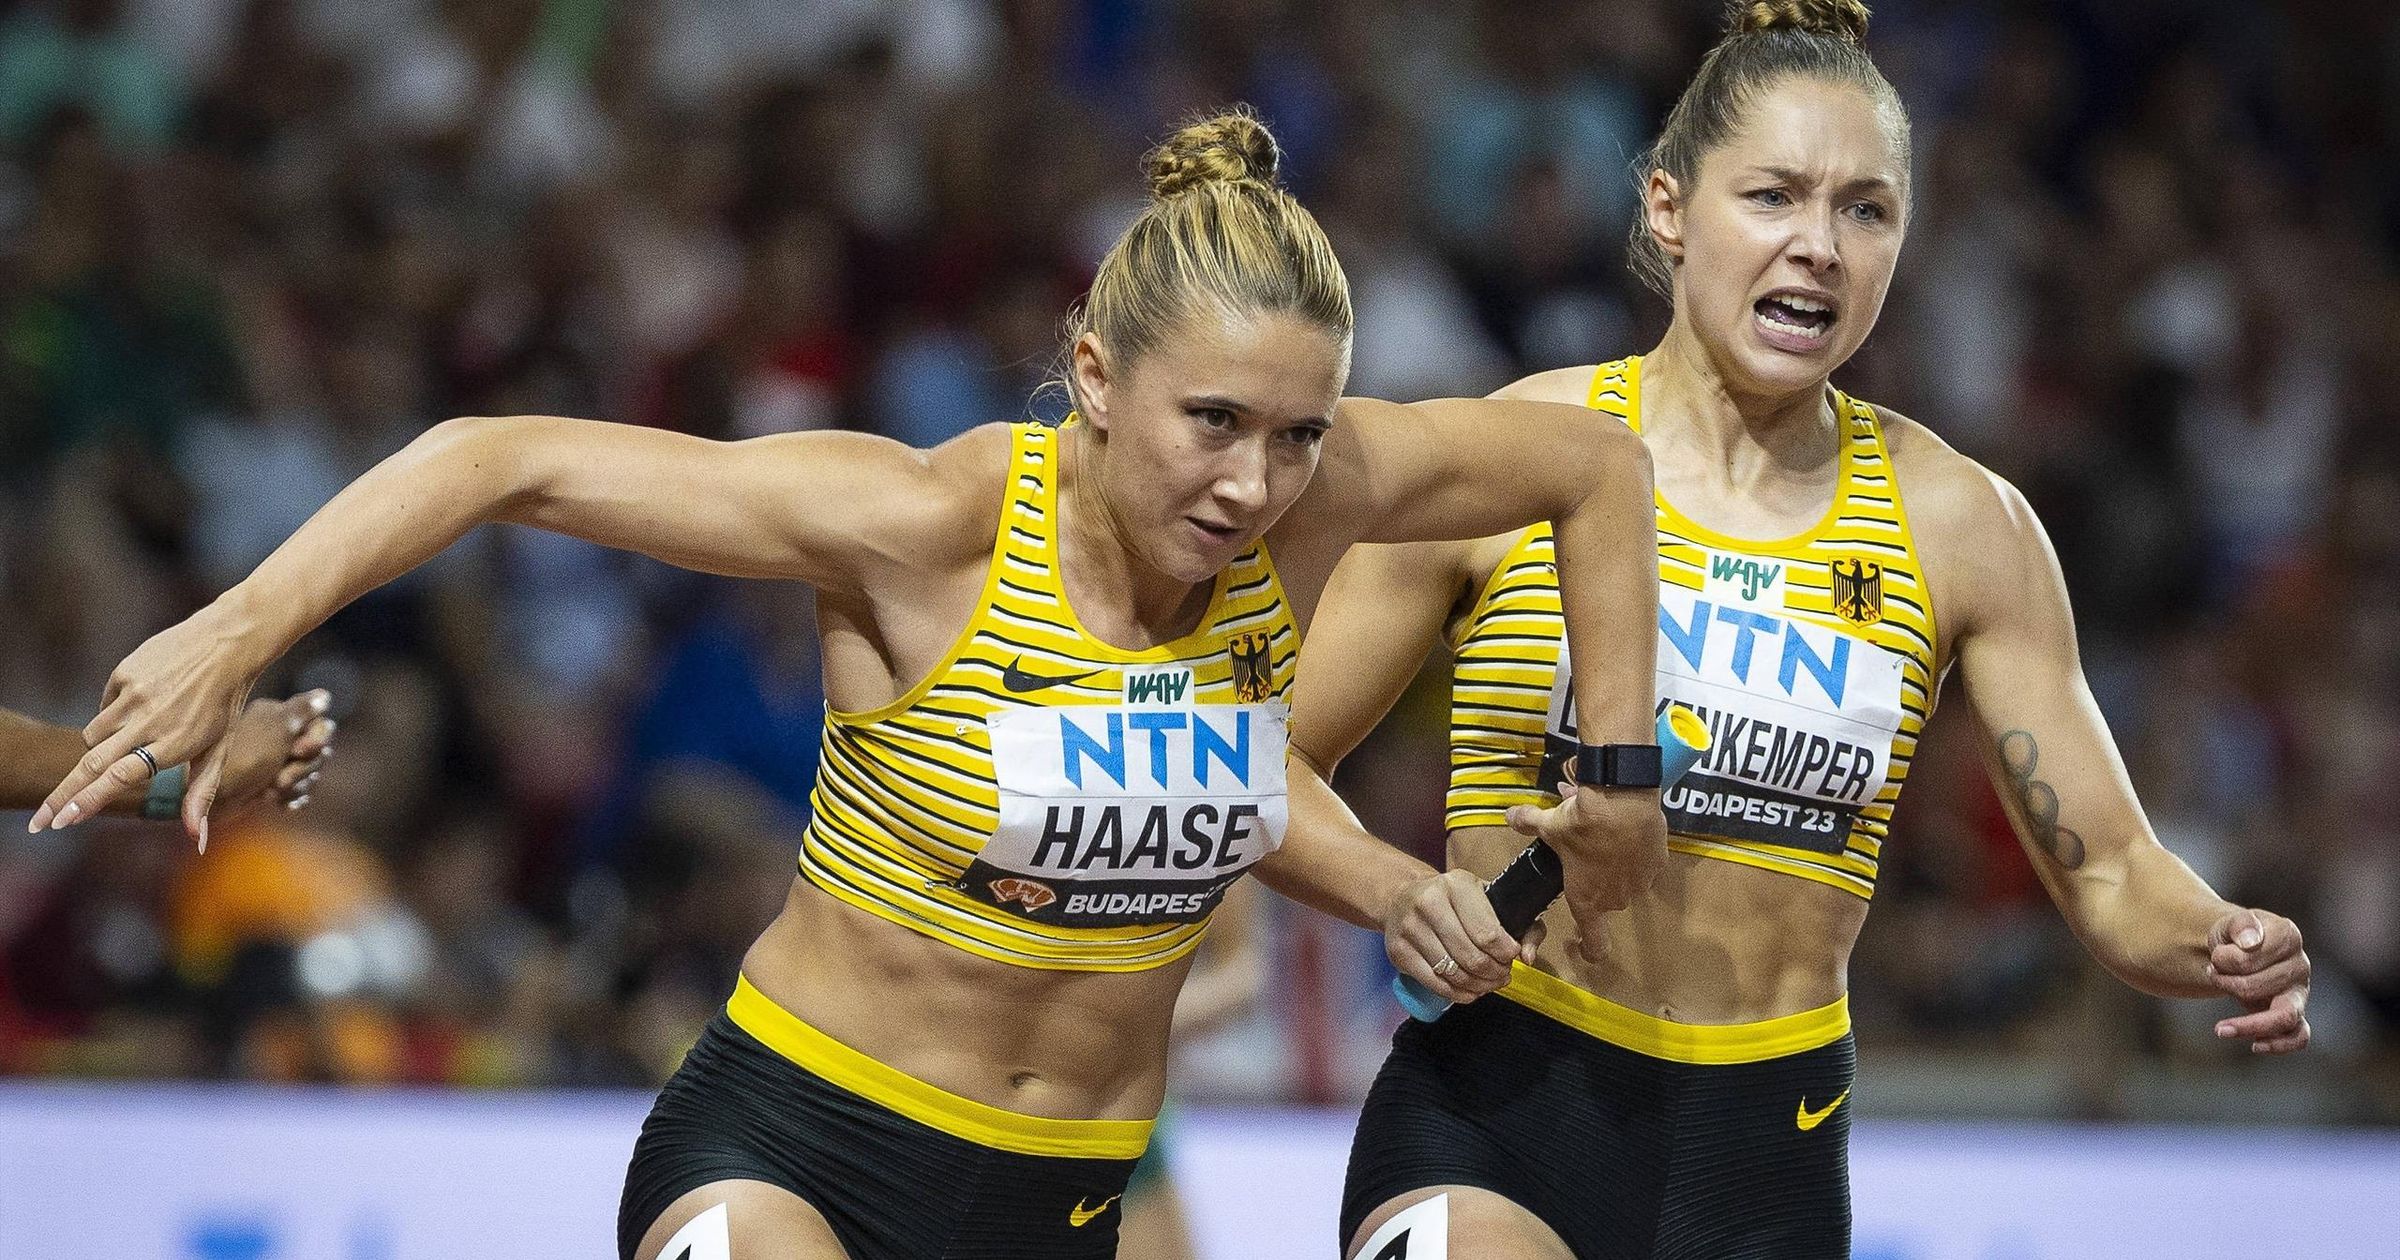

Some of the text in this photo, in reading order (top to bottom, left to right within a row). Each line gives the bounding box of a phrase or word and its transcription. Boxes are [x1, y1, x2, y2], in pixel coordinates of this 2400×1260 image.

[1659, 599, 1852, 712] NTN
[1059, 711, 1250, 791] NTN
[1029, 803, 1259, 871] HAASE
[1661, 786, 1837, 834] UDAPEST 23
[1064, 892, 1210, 915] BUDAPES
